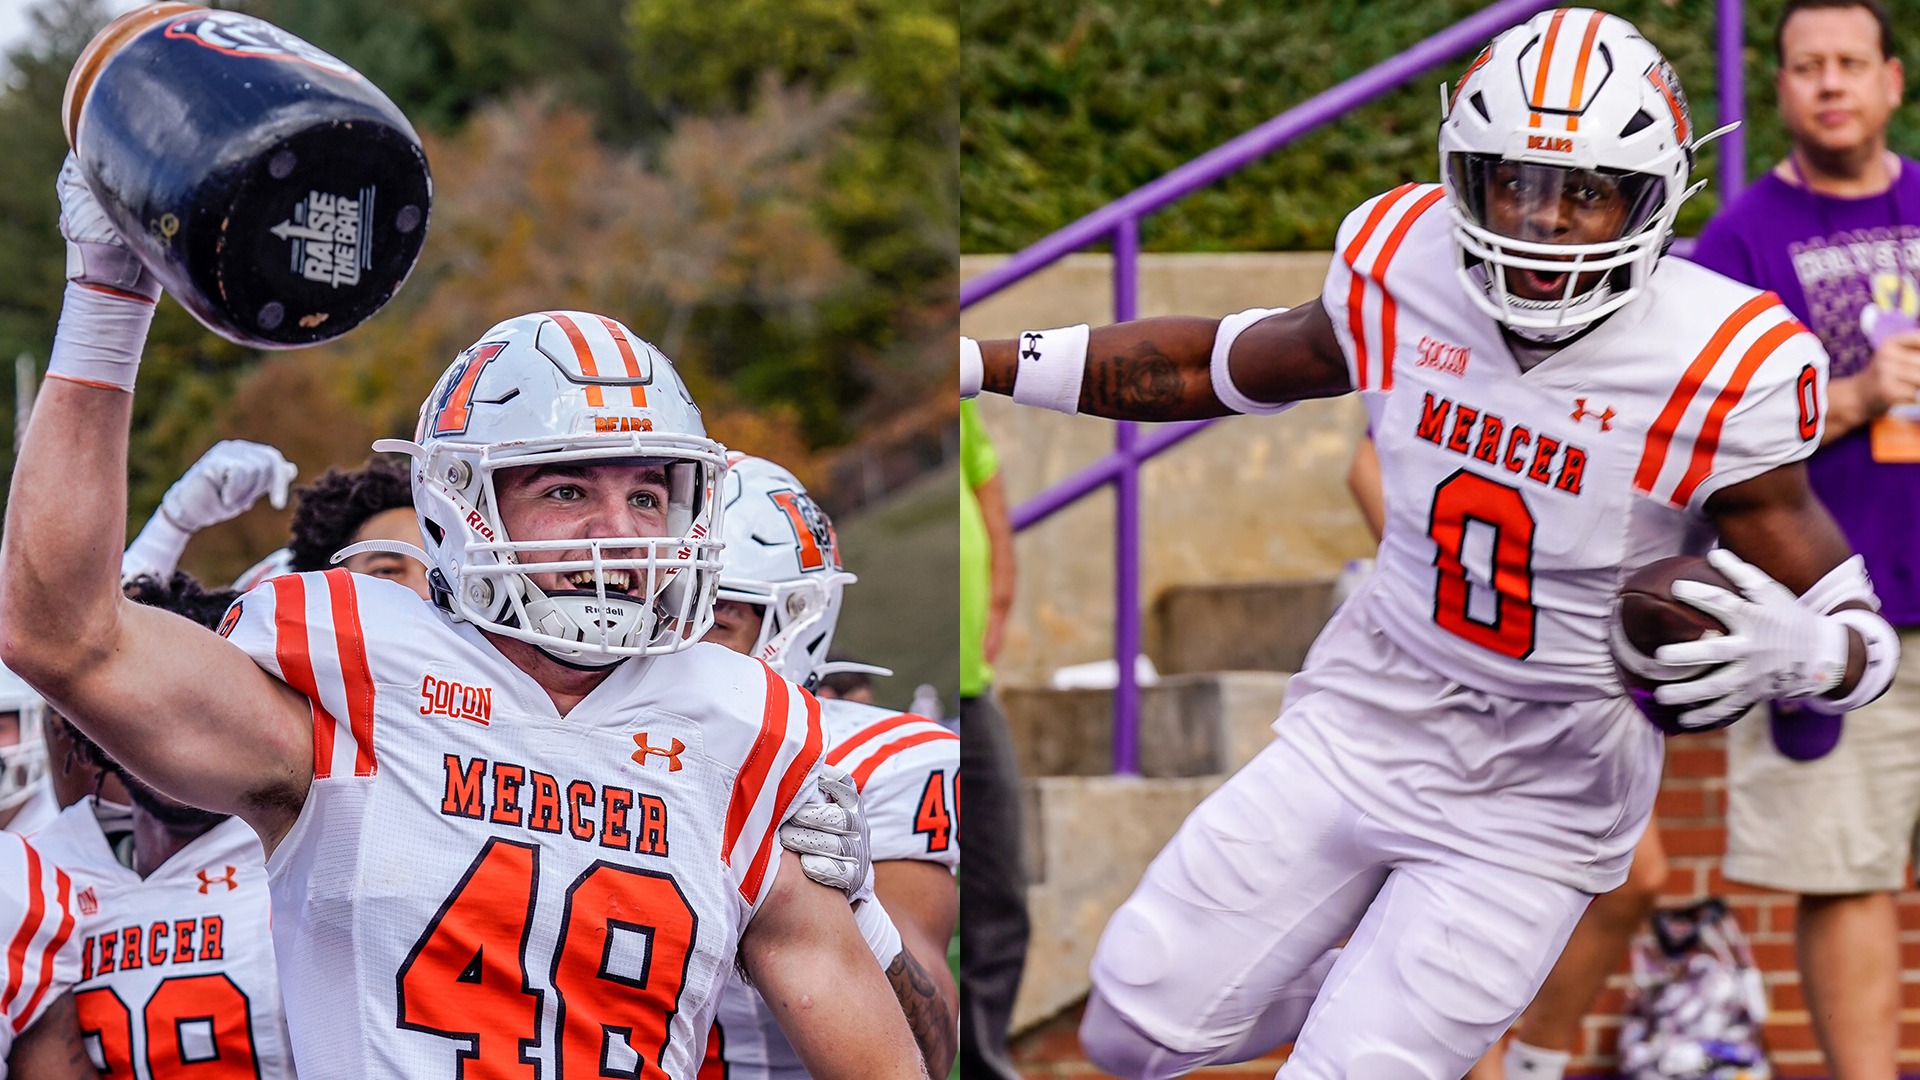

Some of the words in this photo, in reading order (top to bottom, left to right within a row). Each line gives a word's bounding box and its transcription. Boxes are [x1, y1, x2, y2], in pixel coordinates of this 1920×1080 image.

[304, 190, 336, 283] RAISE
[595, 417, 652, 433] BEARS
[1416, 391, 1587, 494] MERCER
[1797, 364, 1819, 441] 0
[1427, 467, 1537, 662] 0
[441, 753, 669, 857] MERCER
[912, 767, 960, 853] 4
[396, 835, 697, 1080] 48
